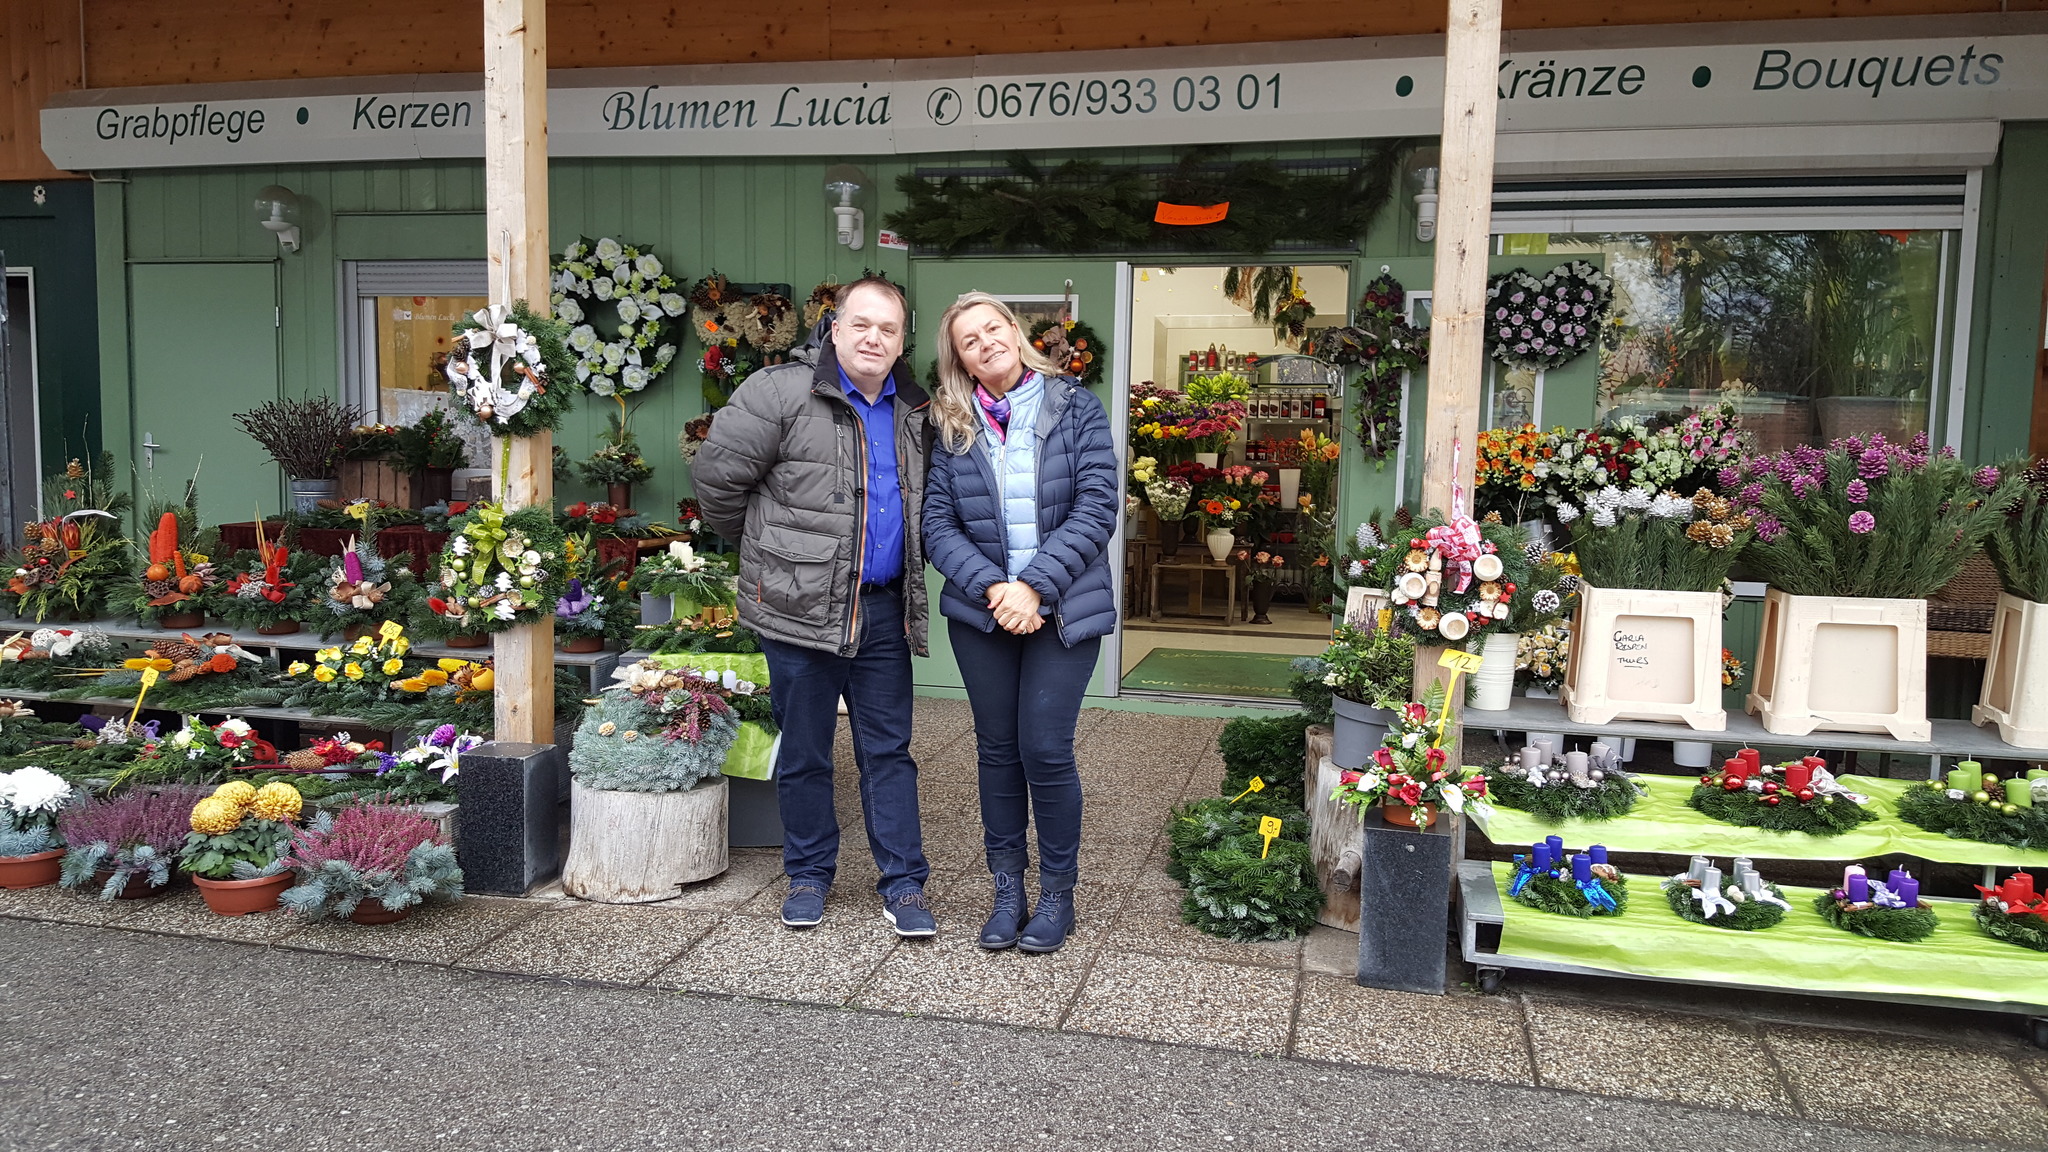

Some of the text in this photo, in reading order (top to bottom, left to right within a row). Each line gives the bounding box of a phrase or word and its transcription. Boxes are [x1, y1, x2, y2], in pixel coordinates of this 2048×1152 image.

[1752, 44, 2005, 98] Bouquets
[352, 96, 472, 131] Kerzen
[602, 82, 892, 131] Blumen Lucia
[976, 72, 1281, 119] 0676/933 03 01
[96, 104, 265, 145] Grabpflege
